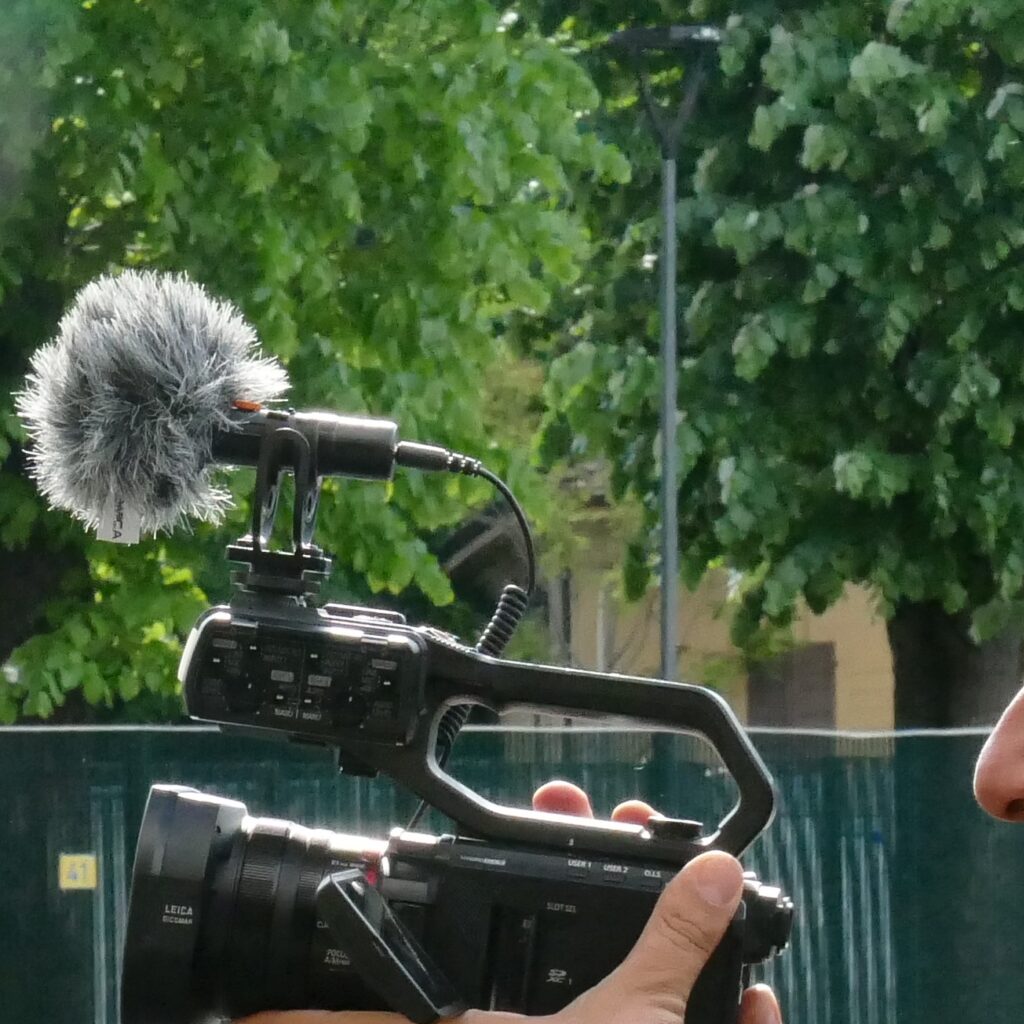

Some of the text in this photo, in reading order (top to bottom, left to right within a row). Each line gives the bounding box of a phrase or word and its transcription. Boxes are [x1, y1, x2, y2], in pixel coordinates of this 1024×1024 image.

[567, 859, 587, 868] USER
[603, 863, 629, 874] USER 2
[164, 904, 193, 916] LEICA
